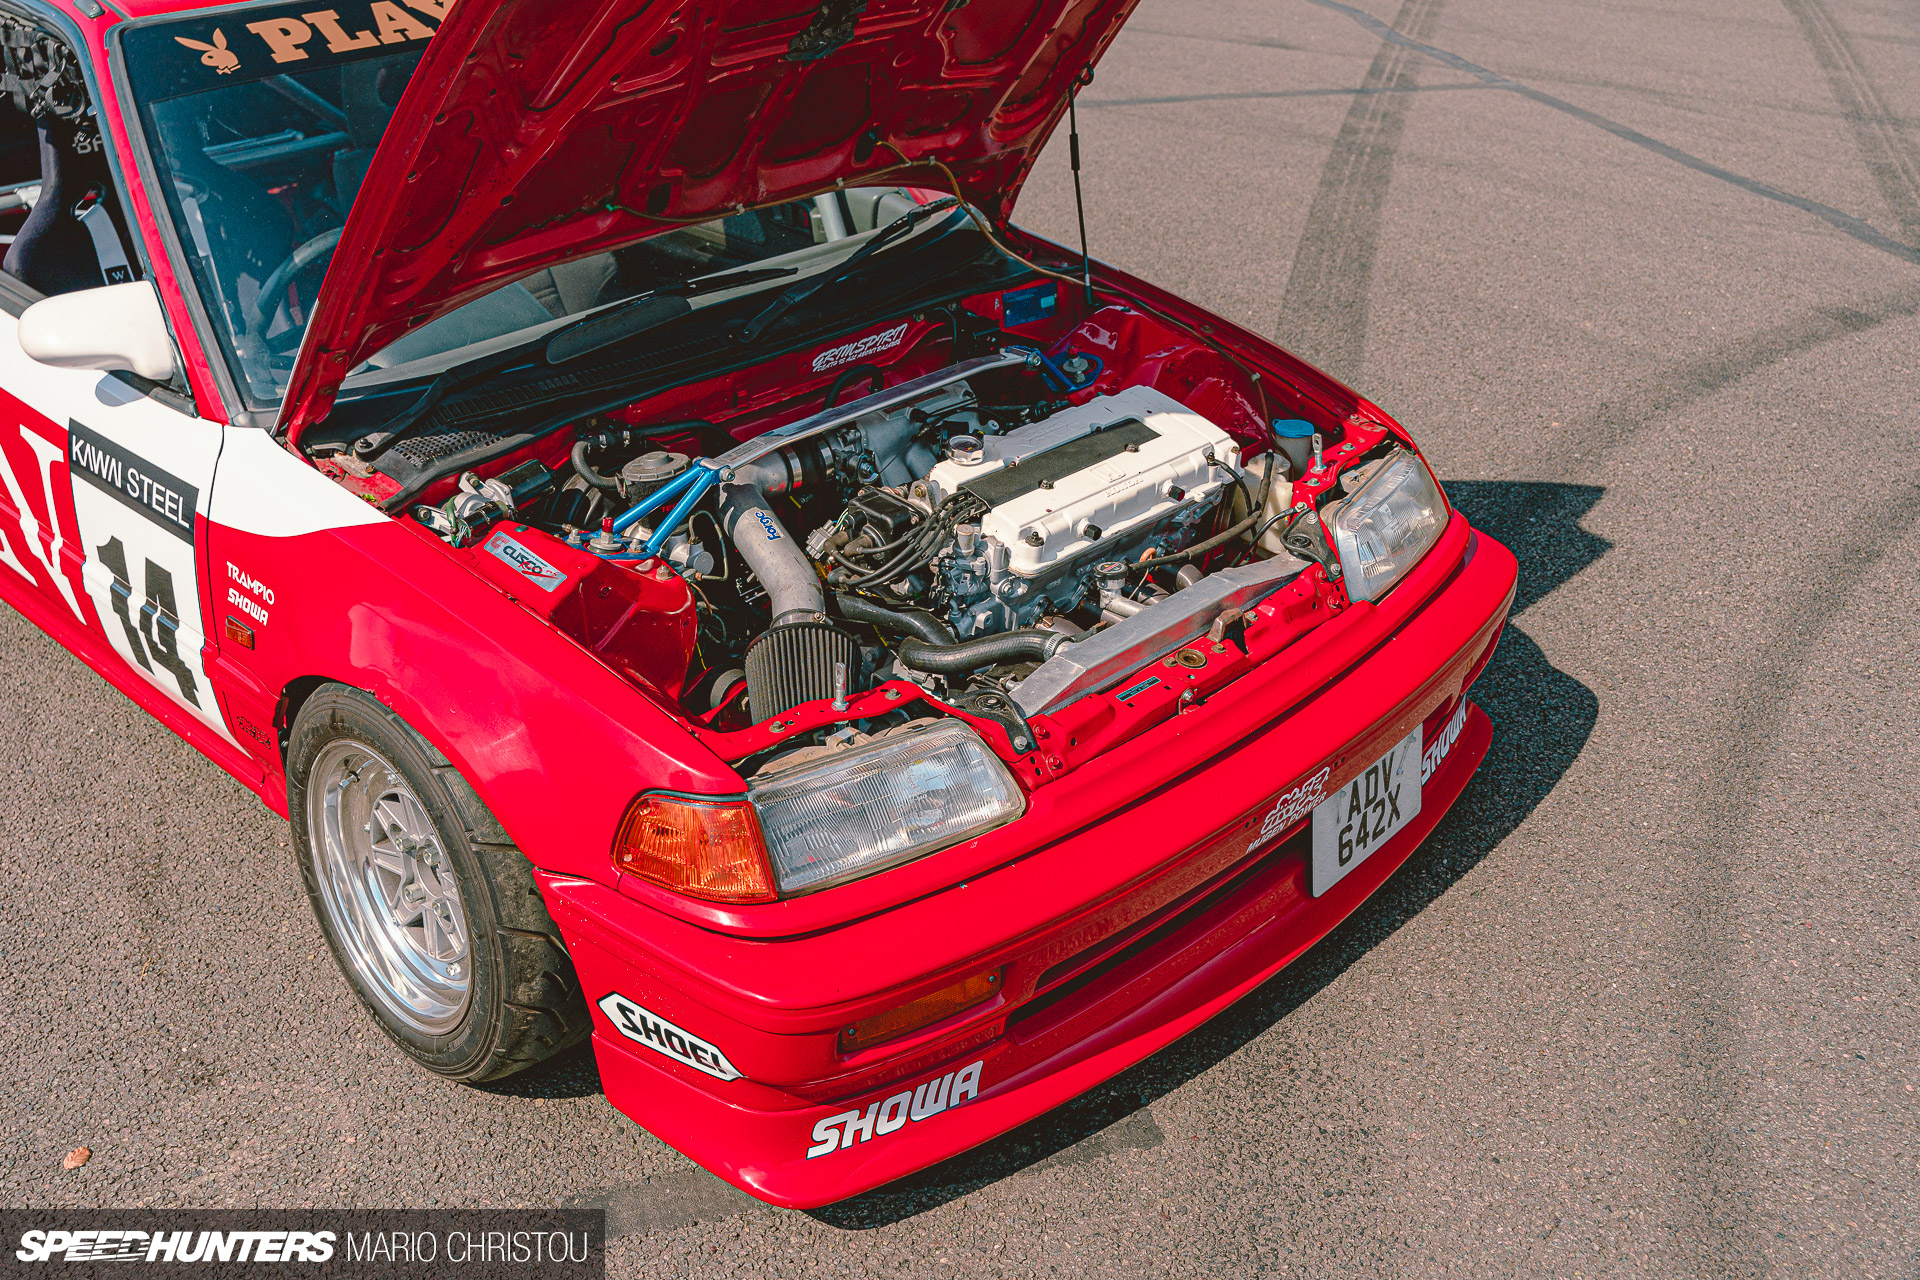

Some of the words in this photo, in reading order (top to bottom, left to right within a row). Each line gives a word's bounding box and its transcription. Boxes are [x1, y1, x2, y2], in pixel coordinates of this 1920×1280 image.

[126, 467, 190, 529] STEEL
[226, 561, 275, 606] TRAMPIO
[227, 587, 269, 627] SHOWA
[96, 535, 203, 711] 14
[1421, 694, 1467, 787] SHOWA
[1245, 820, 1287, 854] MUGEN
[1287, 791, 1327, 826] POWER
[1347, 751, 1395, 824] ADV
[1338, 783, 1401, 868] 642X
[616, 1002, 728, 1075] SHOEI
[806, 1060, 984, 1160] SHOWA
